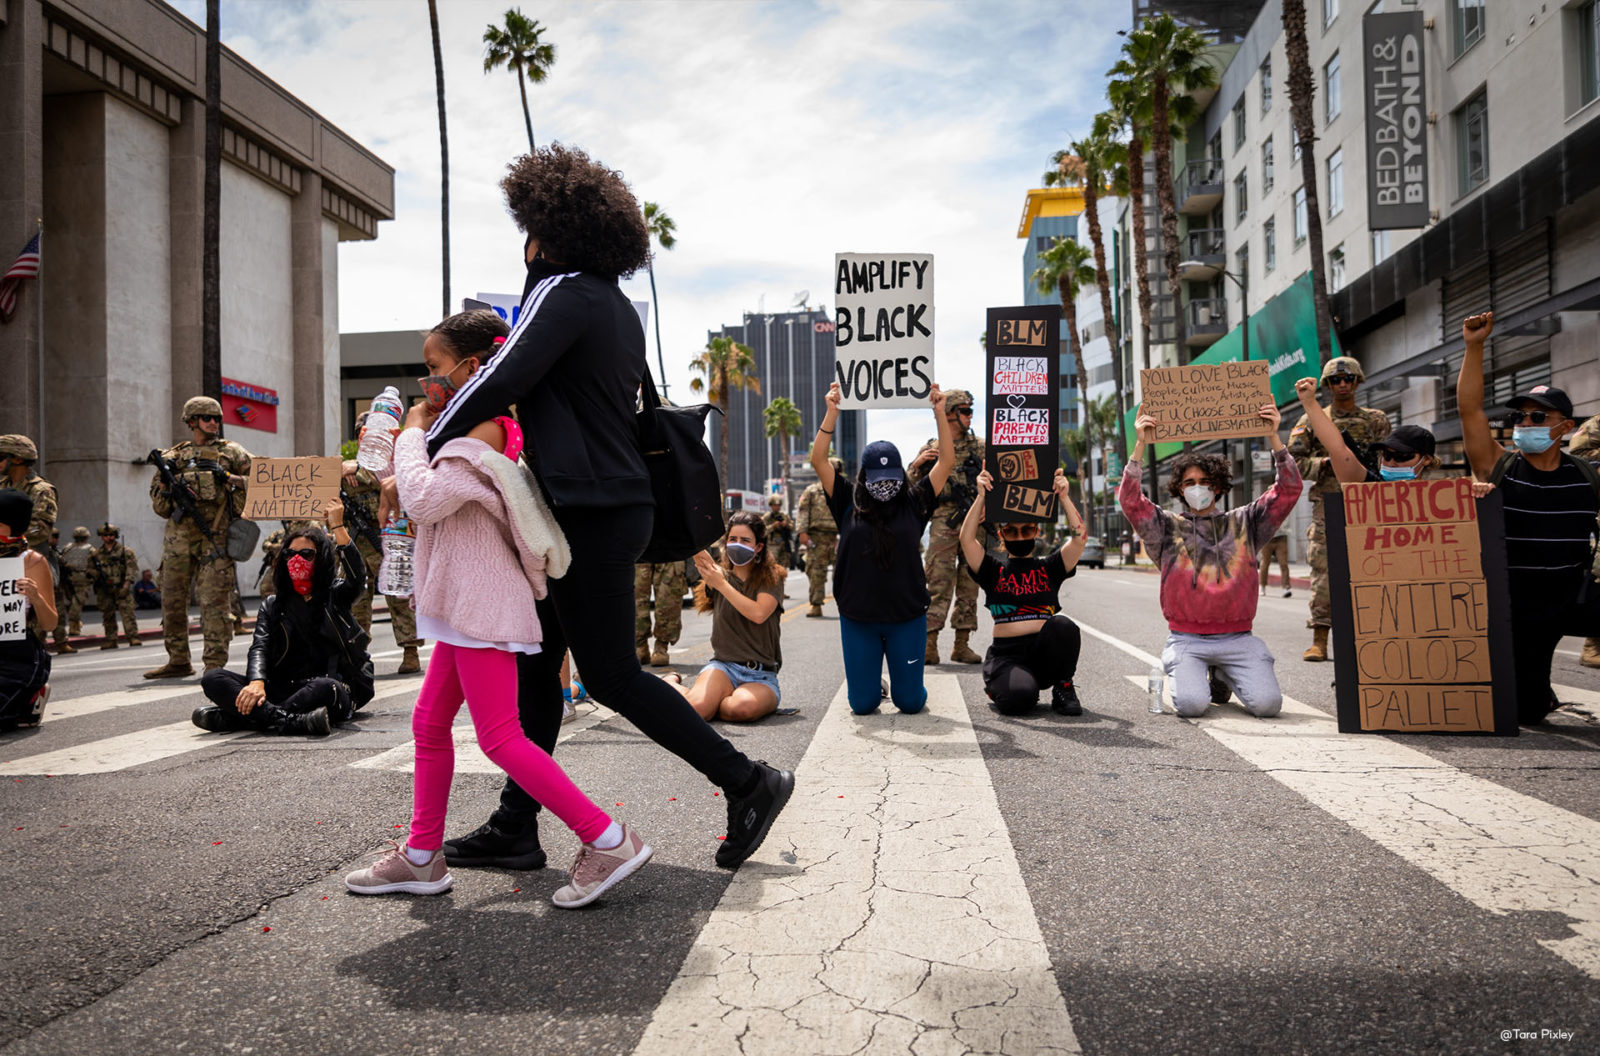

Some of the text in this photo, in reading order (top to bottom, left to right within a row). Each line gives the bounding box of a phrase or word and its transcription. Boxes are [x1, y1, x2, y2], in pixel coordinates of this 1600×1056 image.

[1373, 36, 1400, 205] BED BATH &
[1401, 34, 1423, 203] BEYOND
[836, 259, 929, 294] AMPLIFY
[836, 304, 932, 346] BLACK
[998, 320, 1046, 344] BLM
[836, 355, 932, 401] VOICES
[994, 371, 1048, 384] CHILDREN
[999, 358, 1045, 372] BLACK
[1143, 364, 1269, 386] YOU LOVE BLACK
[996, 408, 1048, 424] BLACK
[1183, 404, 1226, 420] CHOOSE
[995, 423, 1048, 435] PARENTS
[256, 463, 323, 484] BLACK
[1022, 450, 1036, 478] BLM
[273, 483, 315, 499] LIVES
[1005, 486, 1055, 516] BLM
[1344, 478, 1476, 525] AMERICA
[251, 500, 323, 518] MATTER
[1364, 525, 1459, 550] HOME
[1362, 549, 1474, 577] OF THE
[4, 599, 23, 613] WAY
[1353, 581, 1487, 635] ENTIRE
[1358, 640, 1480, 681] COLOR
[1362, 687, 1490, 730] PALLET
